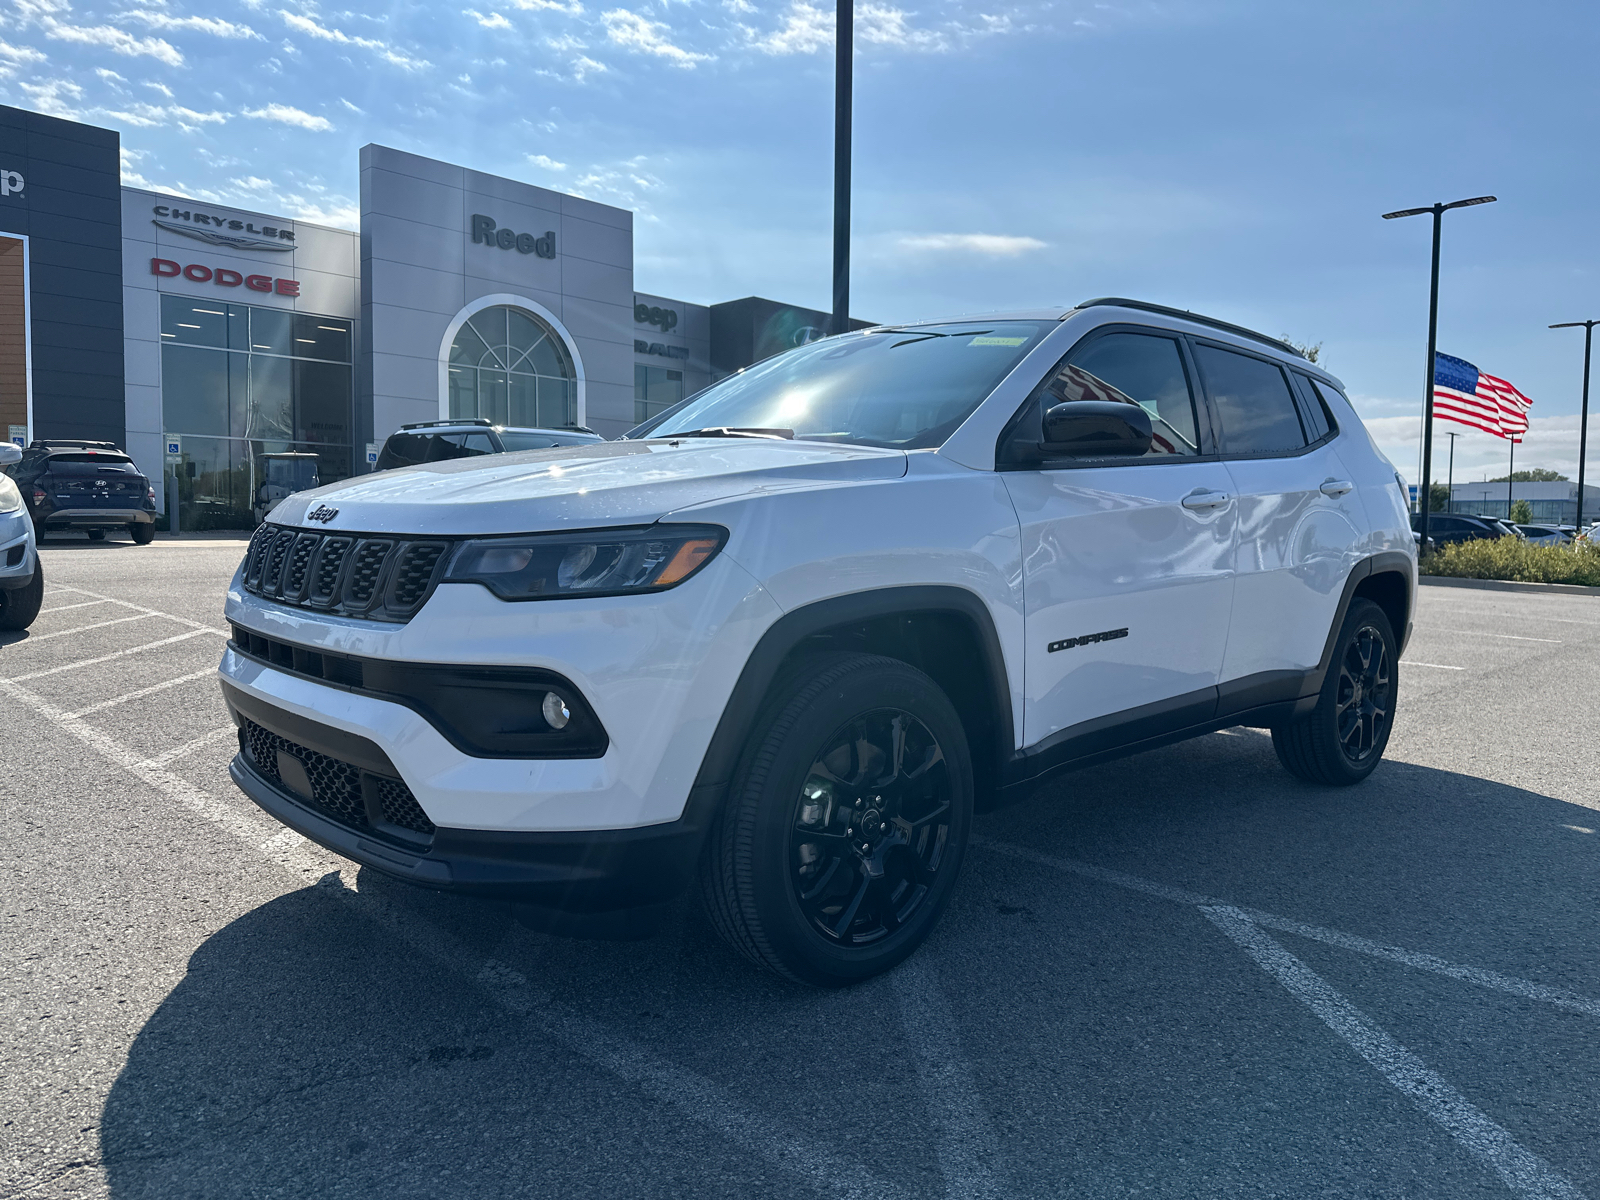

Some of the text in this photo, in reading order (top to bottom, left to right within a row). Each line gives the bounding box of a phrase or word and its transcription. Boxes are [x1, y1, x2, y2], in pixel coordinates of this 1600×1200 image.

[153, 206, 296, 240] CHRYSLER
[471, 213, 556, 260] Reed
[151, 257, 301, 297] DODGE
[634, 295, 678, 333] eep
[634, 339, 690, 360] RAM
[307, 503, 340, 525] Jeep
[1047, 627, 1129, 654] COMPASS
